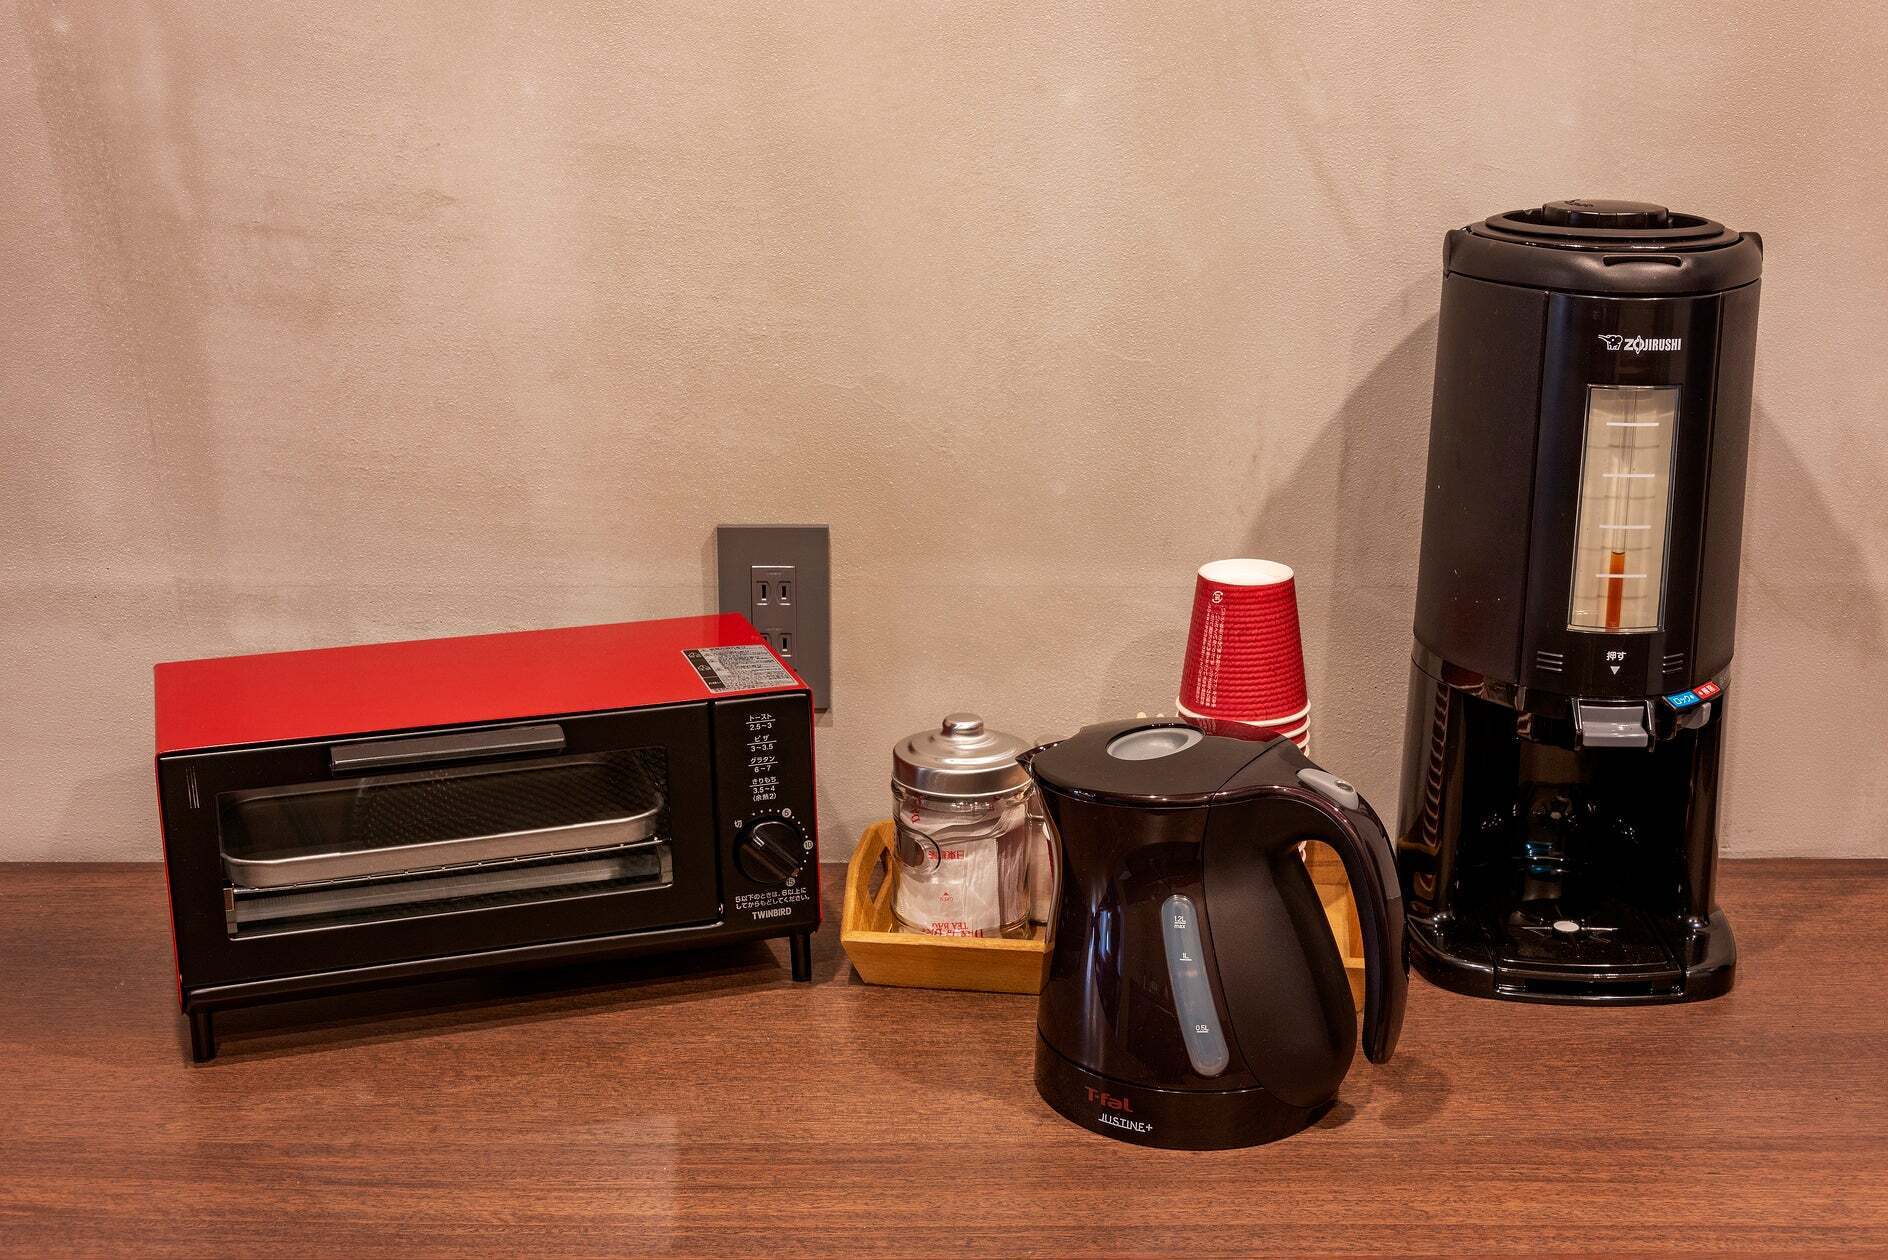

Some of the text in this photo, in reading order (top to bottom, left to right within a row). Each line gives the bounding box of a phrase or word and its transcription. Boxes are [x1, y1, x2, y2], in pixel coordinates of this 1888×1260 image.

[1623, 335, 1682, 355] ZOJIRUSHI
[1605, 651, 1627, 661] 押す
[749, 713, 773, 721] トースト
[750, 756, 776, 765] グラタン
[752, 907, 792, 920] TWINBIRD
